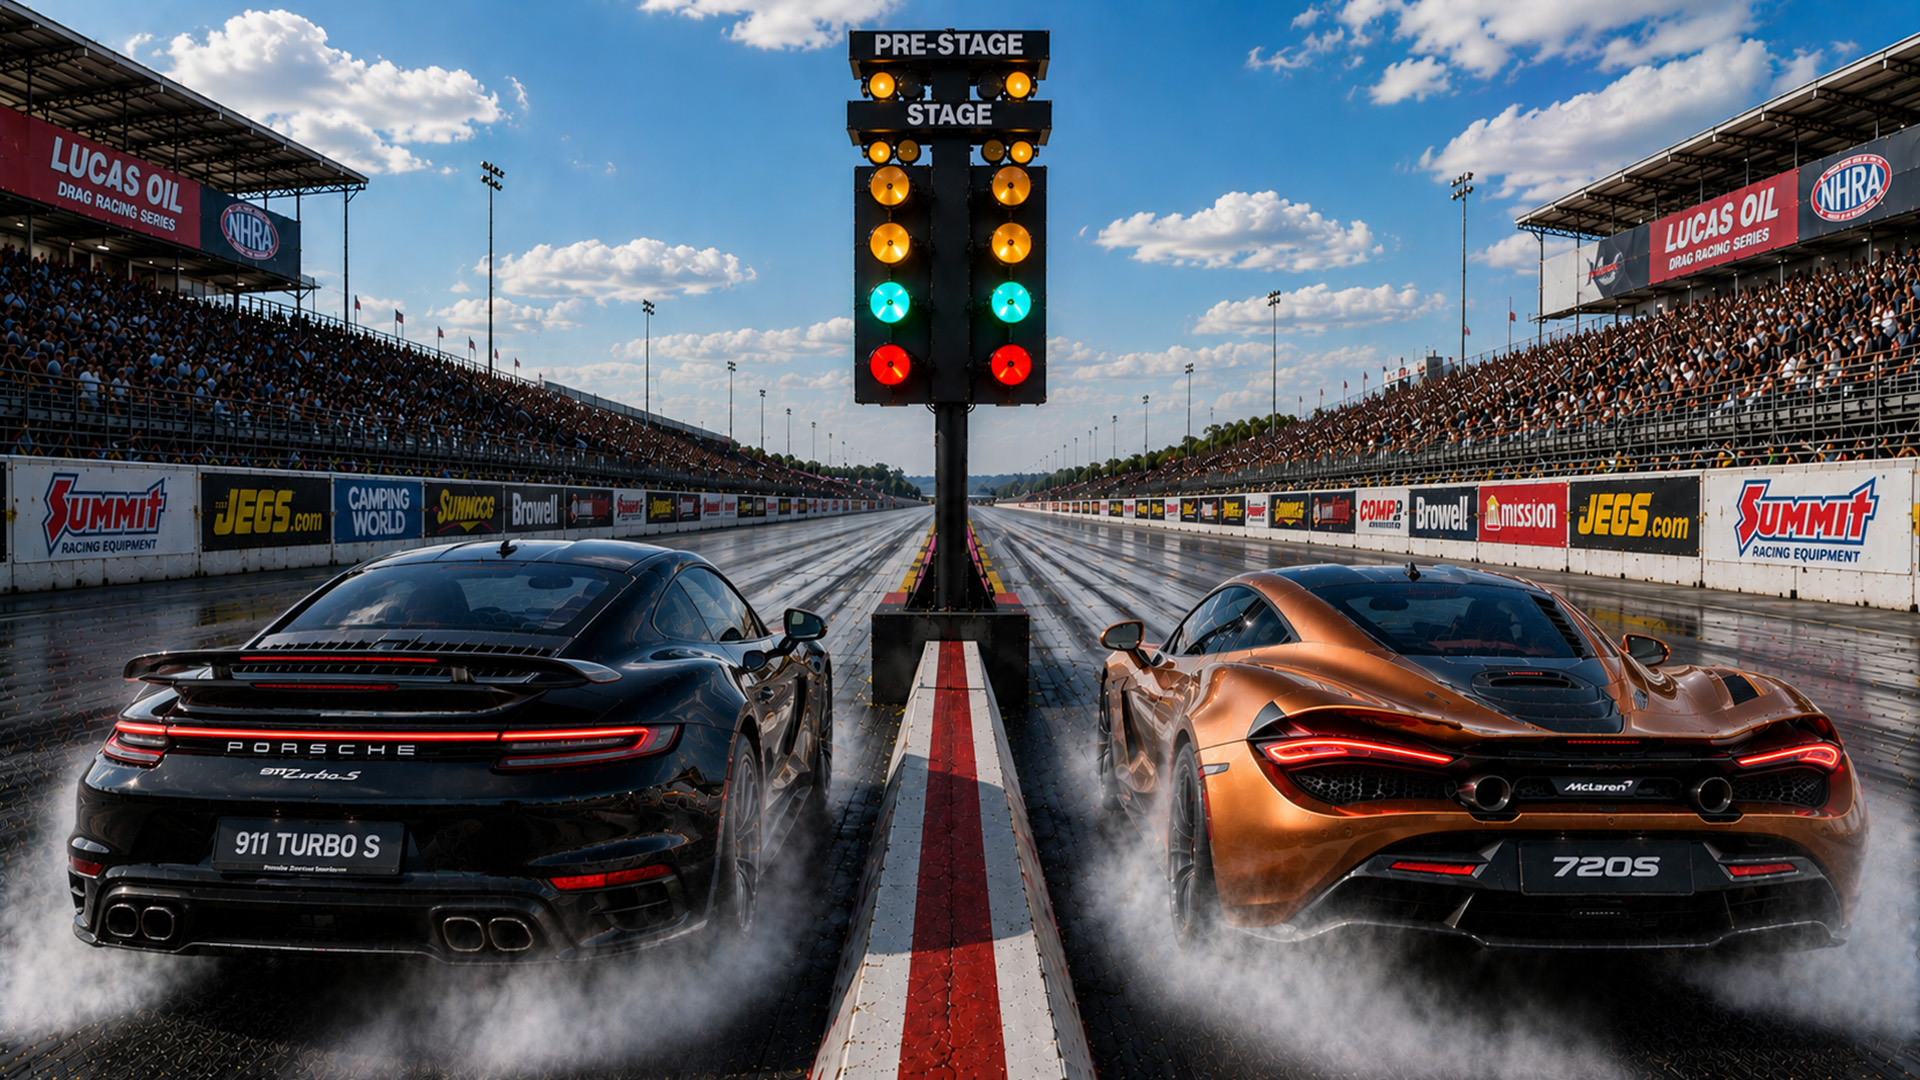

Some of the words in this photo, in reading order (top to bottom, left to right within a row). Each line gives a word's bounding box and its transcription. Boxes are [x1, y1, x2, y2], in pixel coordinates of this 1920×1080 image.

[875, 33, 1023, 56] PRE-STAGE
[907, 103, 993, 126] STAGE
[51, 136, 140, 197] LUCAS
[146, 173, 183, 214] OIL
[1821, 163, 1881, 211] NHRA
[57, 182, 92, 205] DRAG
[96, 195, 137, 221] RACING
[140, 211, 176, 232] SERIES
[1665, 201, 1734, 253] LUCAS
[1740, 186, 1779, 228] OIL
[229, 213, 274, 251] NHRA
[1669, 252, 1693, 271] DRAG
[1694, 240, 1731, 264] RACING
[1733, 227, 1770, 252] SERIES
[213, 488, 323, 536] JEGS.com
[348, 486, 410, 510] CAMPING
[512, 492, 558, 527] Browell
[1416, 495, 1469, 532] Browell
[1502, 498, 1556, 529] mission
[352, 510, 406, 537] WORLD
[1577, 492, 1689, 540] JEGS.com
[61, 540, 100, 554] RACING
[103, 538, 157, 553] EQUIPMENT
[1752, 545, 1791, 560] RACING
[1794, 547, 1861, 563] EQUIPMENT
[227, 741, 416, 756] PORSCHE
[1564, 781, 1628, 792] McLaren
[235, 831, 270, 855] 911
[276, 832, 358, 858] TURBO
[363, 834, 381, 859] S
[1552, 856, 1661, 877] 720S
